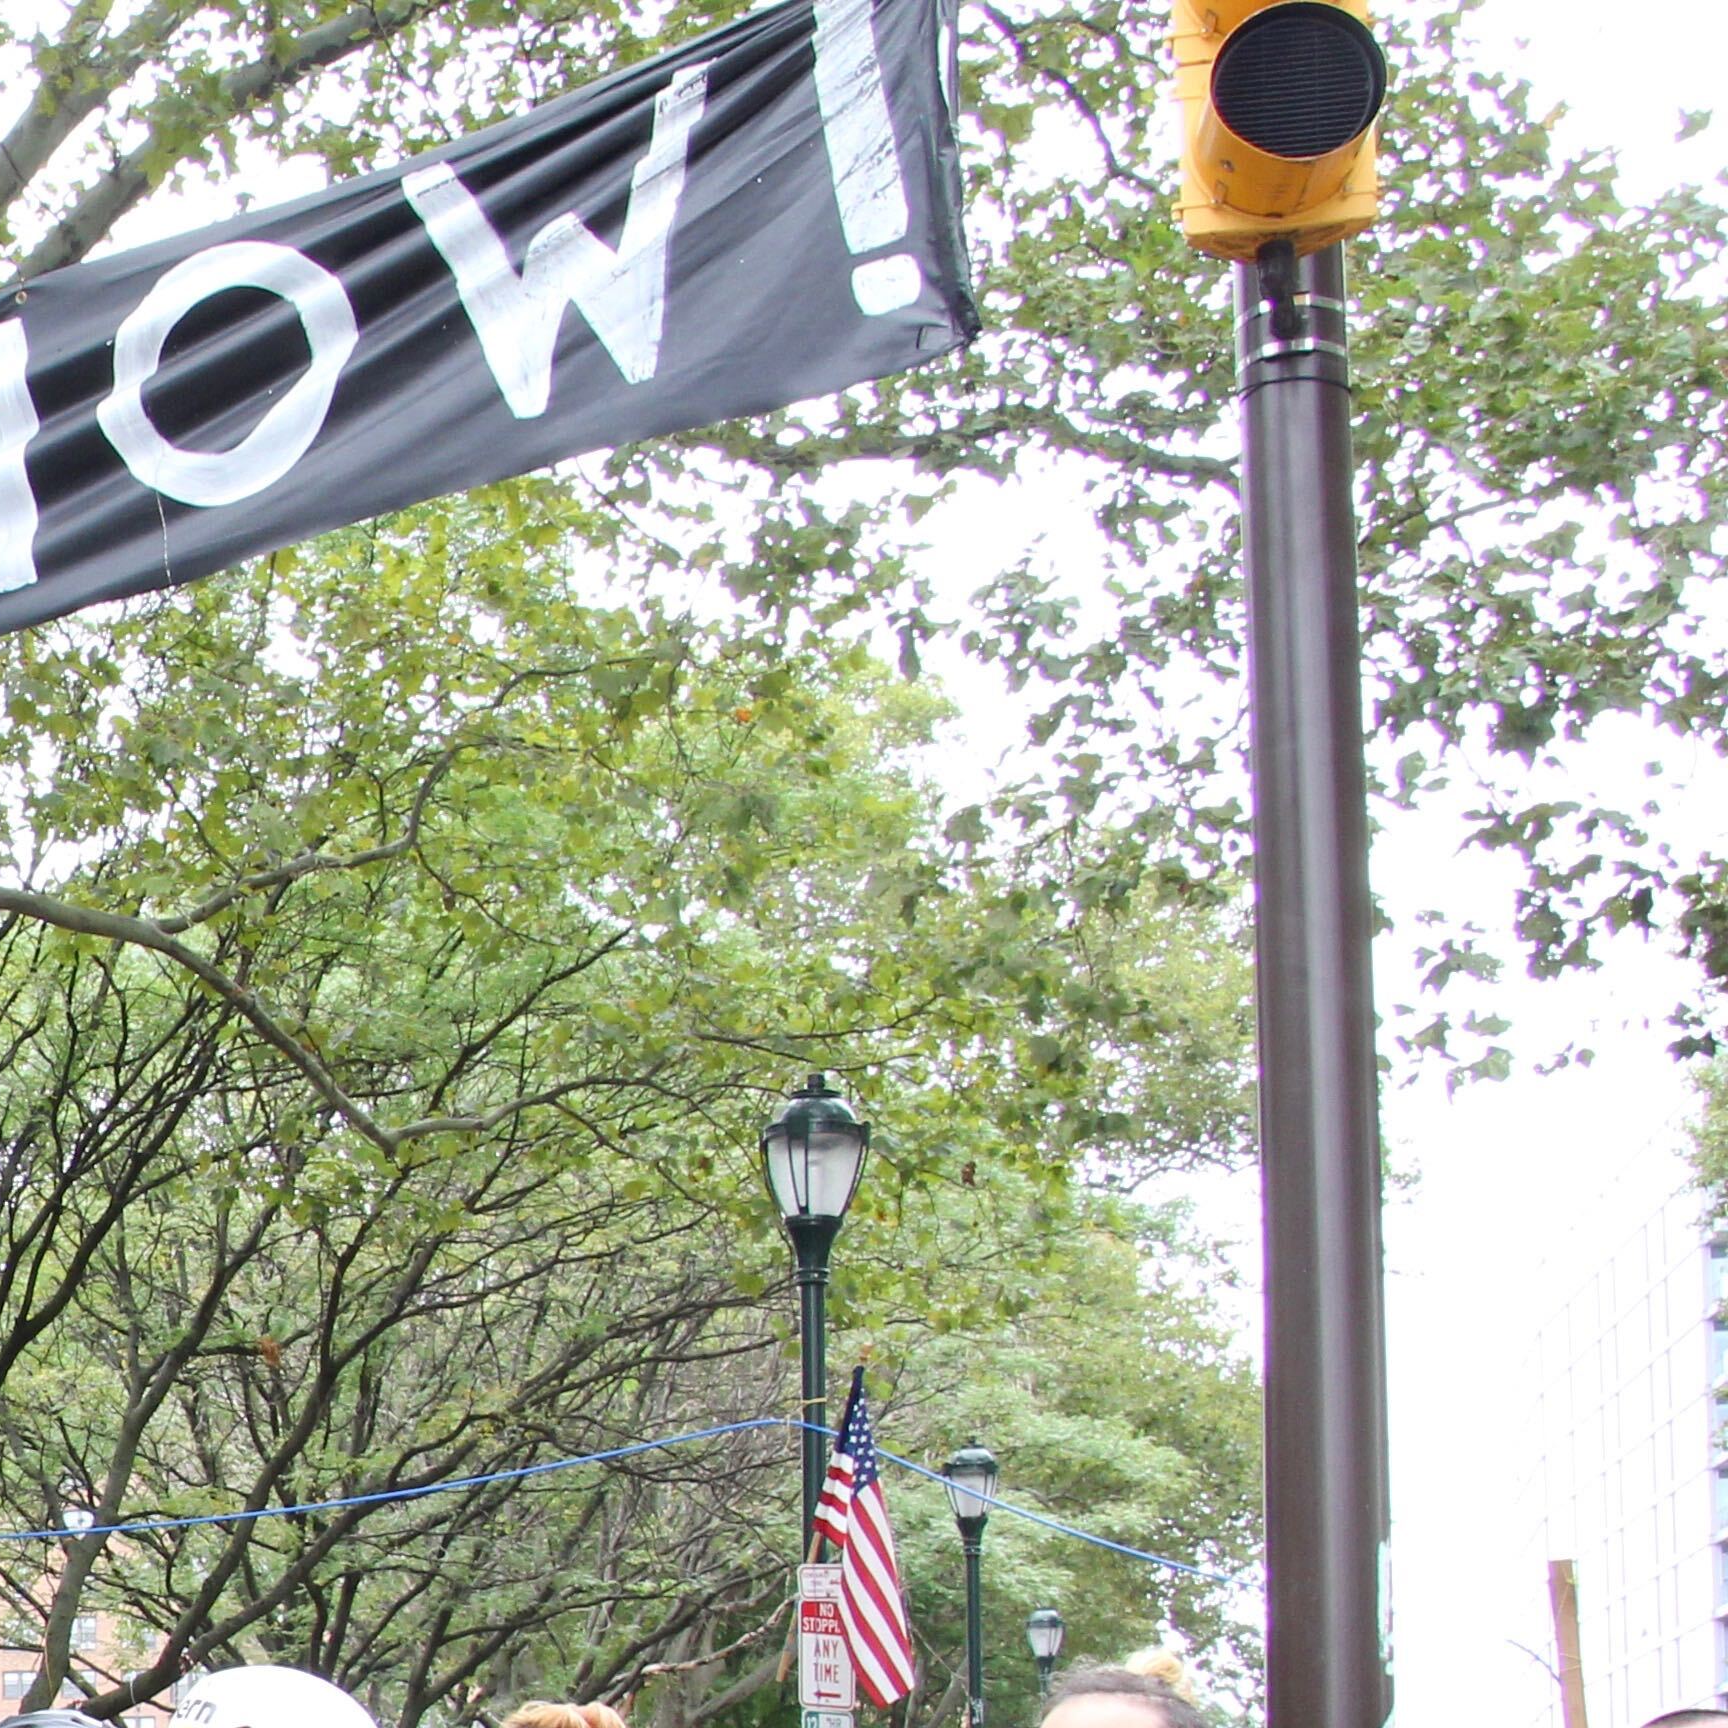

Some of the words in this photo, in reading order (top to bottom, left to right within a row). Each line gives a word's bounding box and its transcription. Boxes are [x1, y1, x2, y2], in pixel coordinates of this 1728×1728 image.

[819, 1603, 834, 1617] NO
[814, 1639, 840, 1659] ANY
[813, 1663, 840, 1684] TIME
